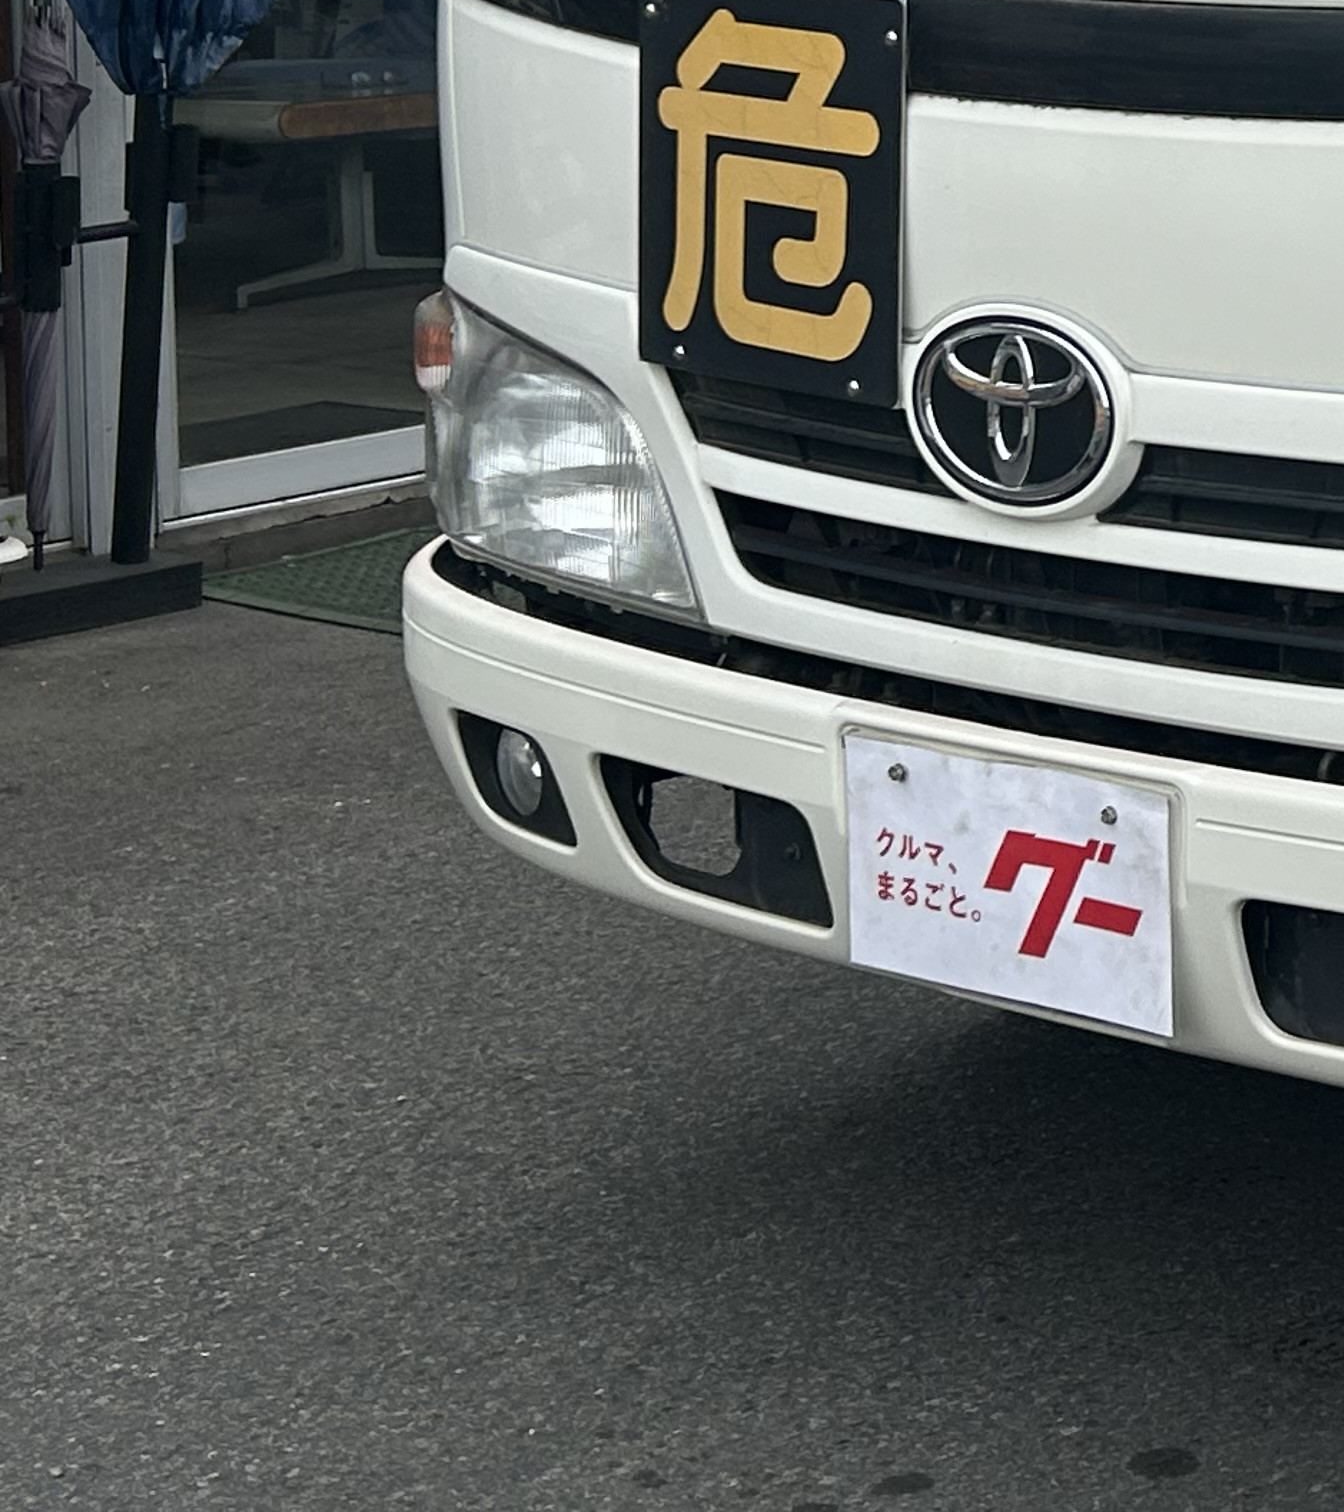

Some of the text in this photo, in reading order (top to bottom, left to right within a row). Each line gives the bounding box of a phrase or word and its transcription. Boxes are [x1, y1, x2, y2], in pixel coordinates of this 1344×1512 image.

[657, 7, 881, 362] 危
[876, 826, 958, 875] クルマ、
[983, 829, 1144, 959] グー
[876, 871, 982, 923] まるごと。
